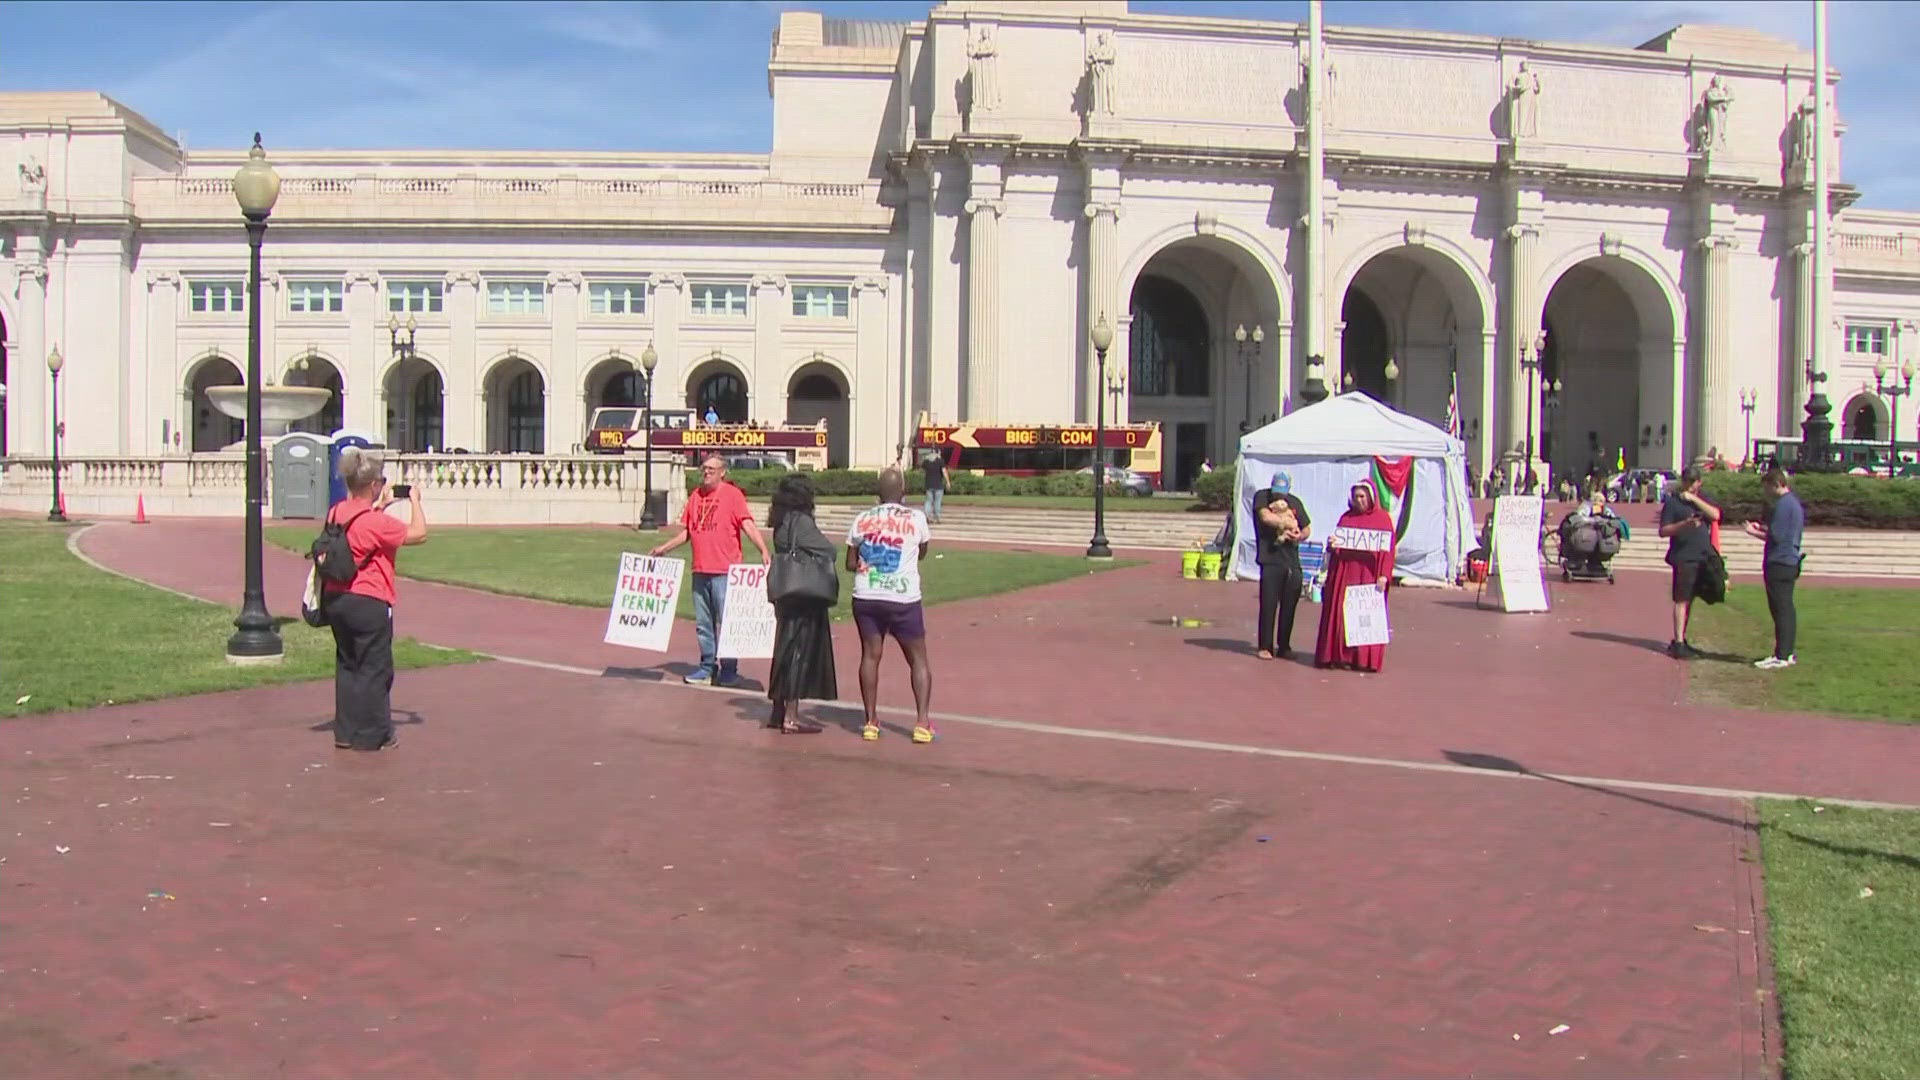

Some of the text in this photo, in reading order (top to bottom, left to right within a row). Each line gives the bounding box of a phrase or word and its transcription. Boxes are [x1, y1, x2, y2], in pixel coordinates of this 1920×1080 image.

[682, 432, 765, 446] BIGBUS.COM
[1005, 431, 1093, 444] BIGBUS.COM
[1334, 528, 1390, 550] SHAME
[623, 555, 680, 578] REINSTATE
[621, 574, 675, 599] FLARE'S
[729, 567, 765, 589] STOP
[619, 614, 656, 629] NOW!
